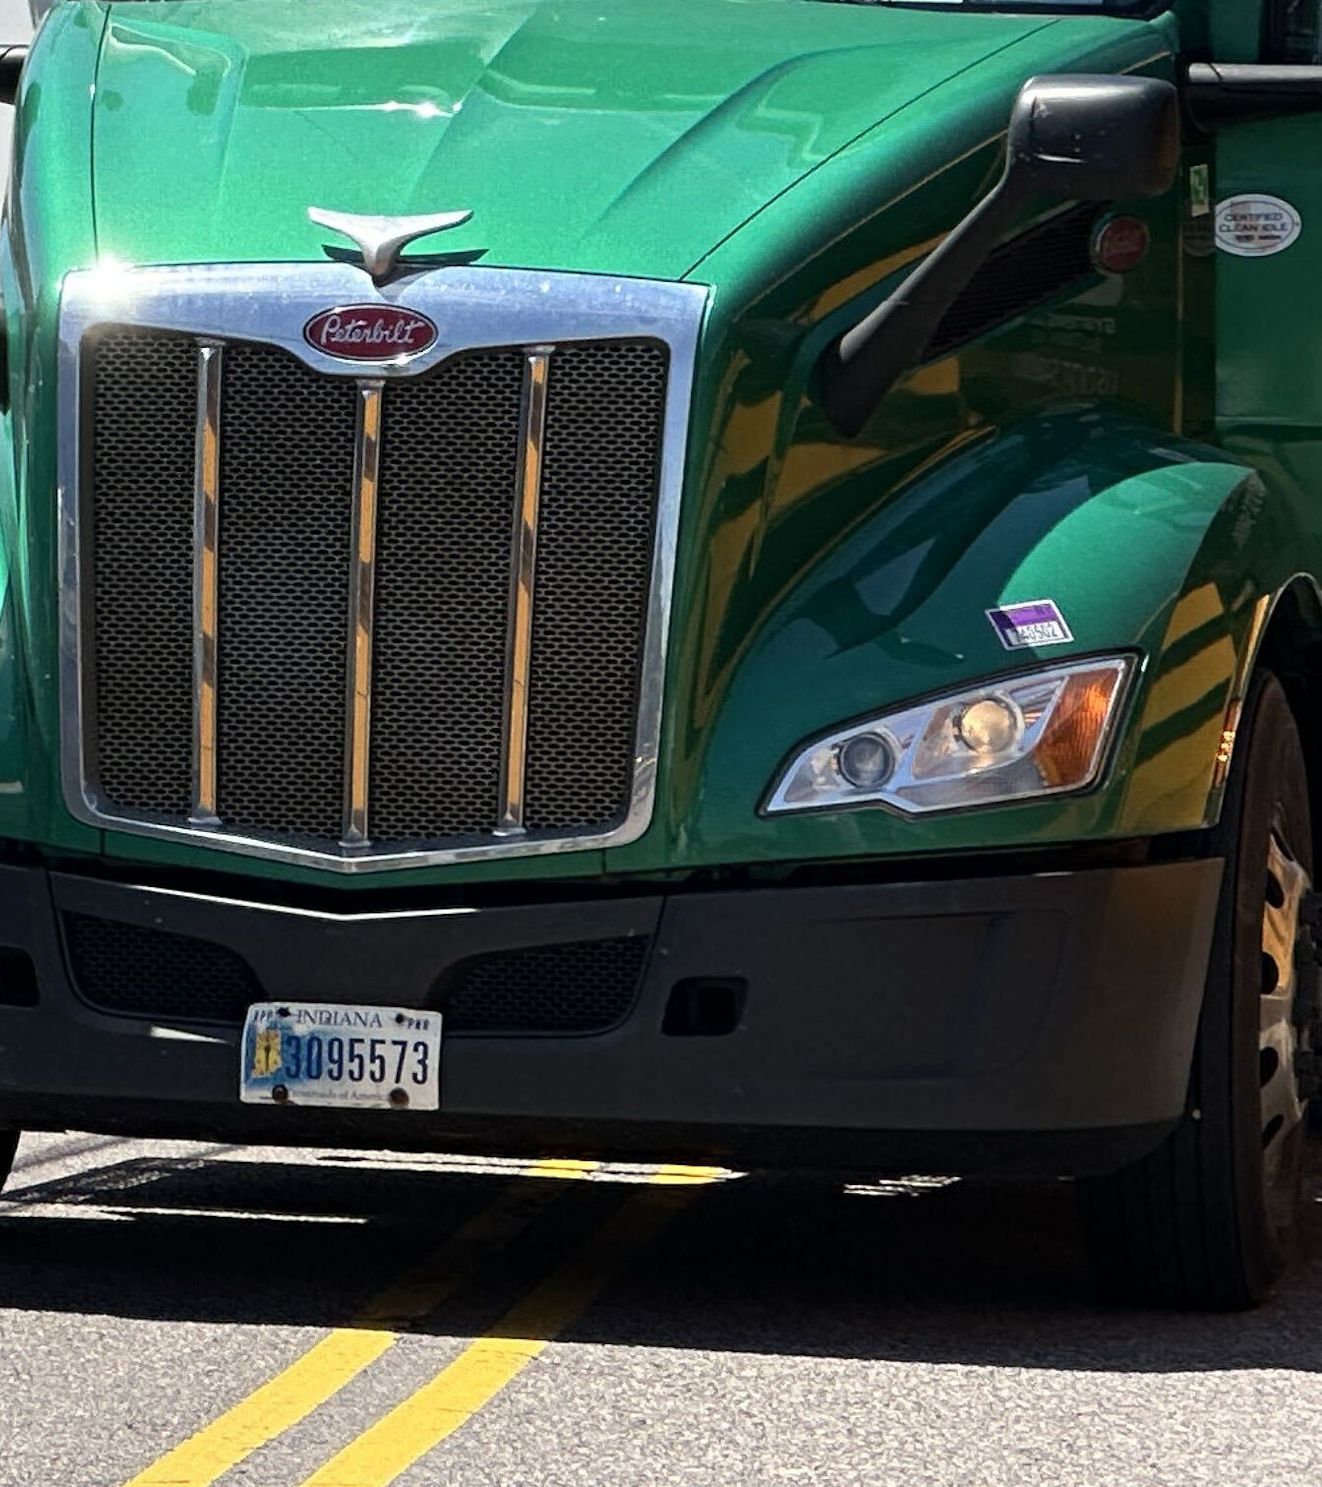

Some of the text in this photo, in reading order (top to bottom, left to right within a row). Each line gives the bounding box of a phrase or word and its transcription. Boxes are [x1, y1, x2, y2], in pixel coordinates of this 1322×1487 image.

[321, 315, 425, 345] Peterbilt
[297, 1009, 383, 1029] INDIANA
[285, 1035, 429, 1085] 3095573
